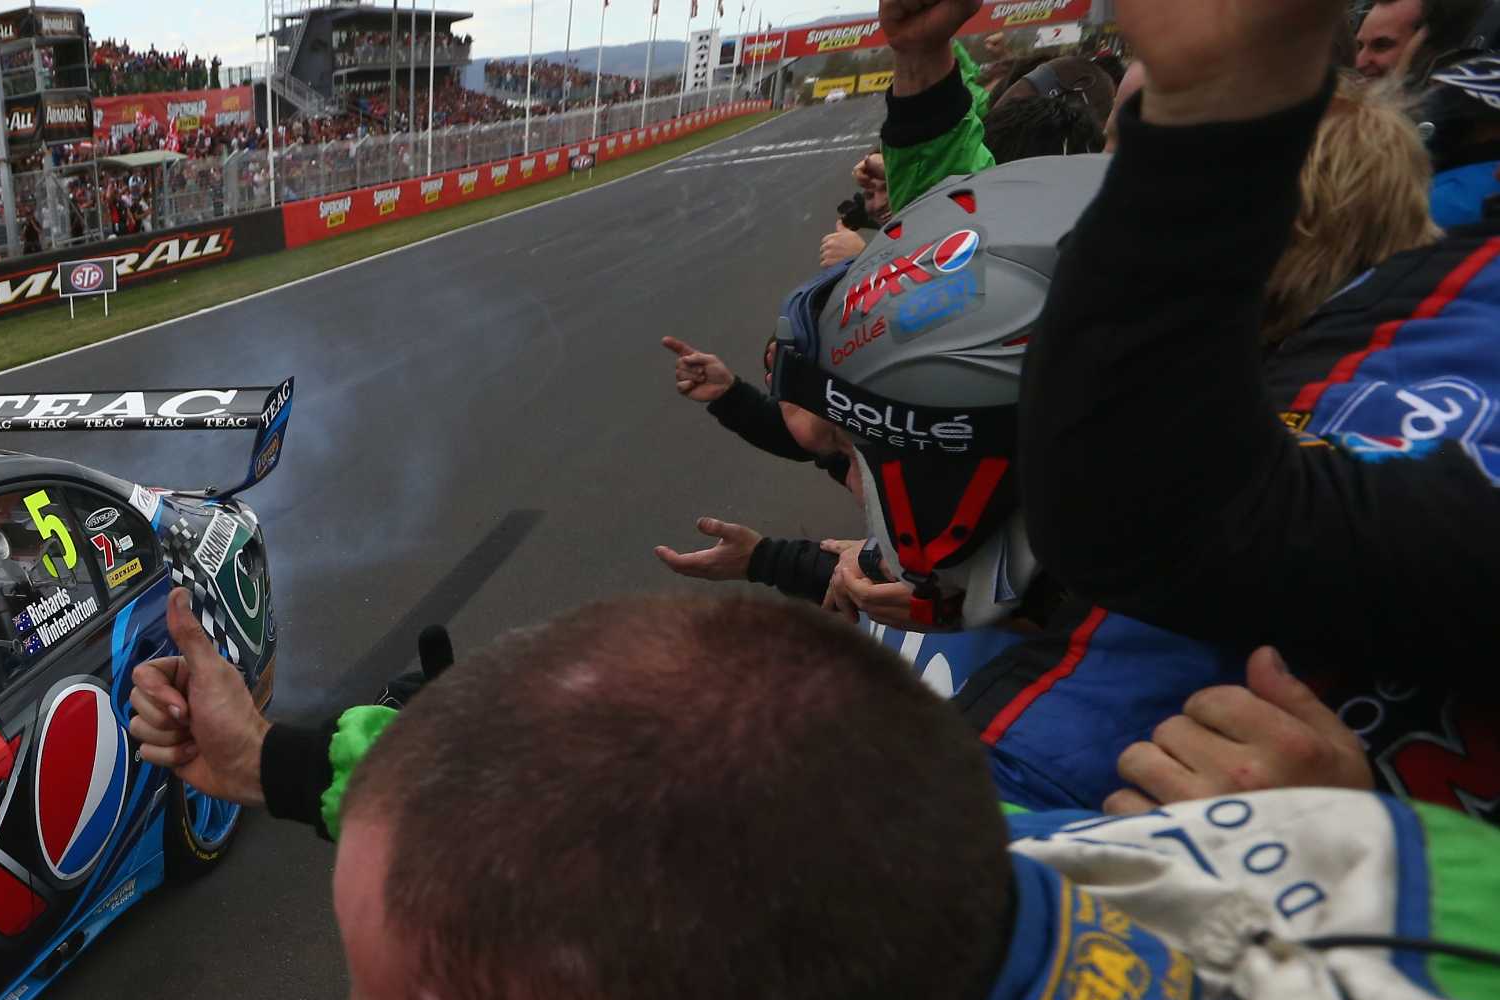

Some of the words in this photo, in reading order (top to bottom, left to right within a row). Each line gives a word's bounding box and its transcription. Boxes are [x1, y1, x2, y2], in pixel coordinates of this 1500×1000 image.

[806, 21, 880, 45] SUPERCHEAP
[10, 112, 33, 130] ALL
[72, 104, 88, 122] ALL
[138, 232, 225, 272] ALL
[74, 266, 101, 287] STP
[840, 240, 936, 328] MAX
[28, 419, 67, 429] TEAC
[84, 418, 124, 428] TEAC
[142, 417, 184, 427] TEAC
[203, 417, 248, 427] TEAC
[261, 380, 290, 429] TEAC
[826, 378, 973, 439] bollé
[22, 489, 78, 579] 5
[27, 586, 71, 627] Richards
[36, 595, 99, 649] Winterbottom
